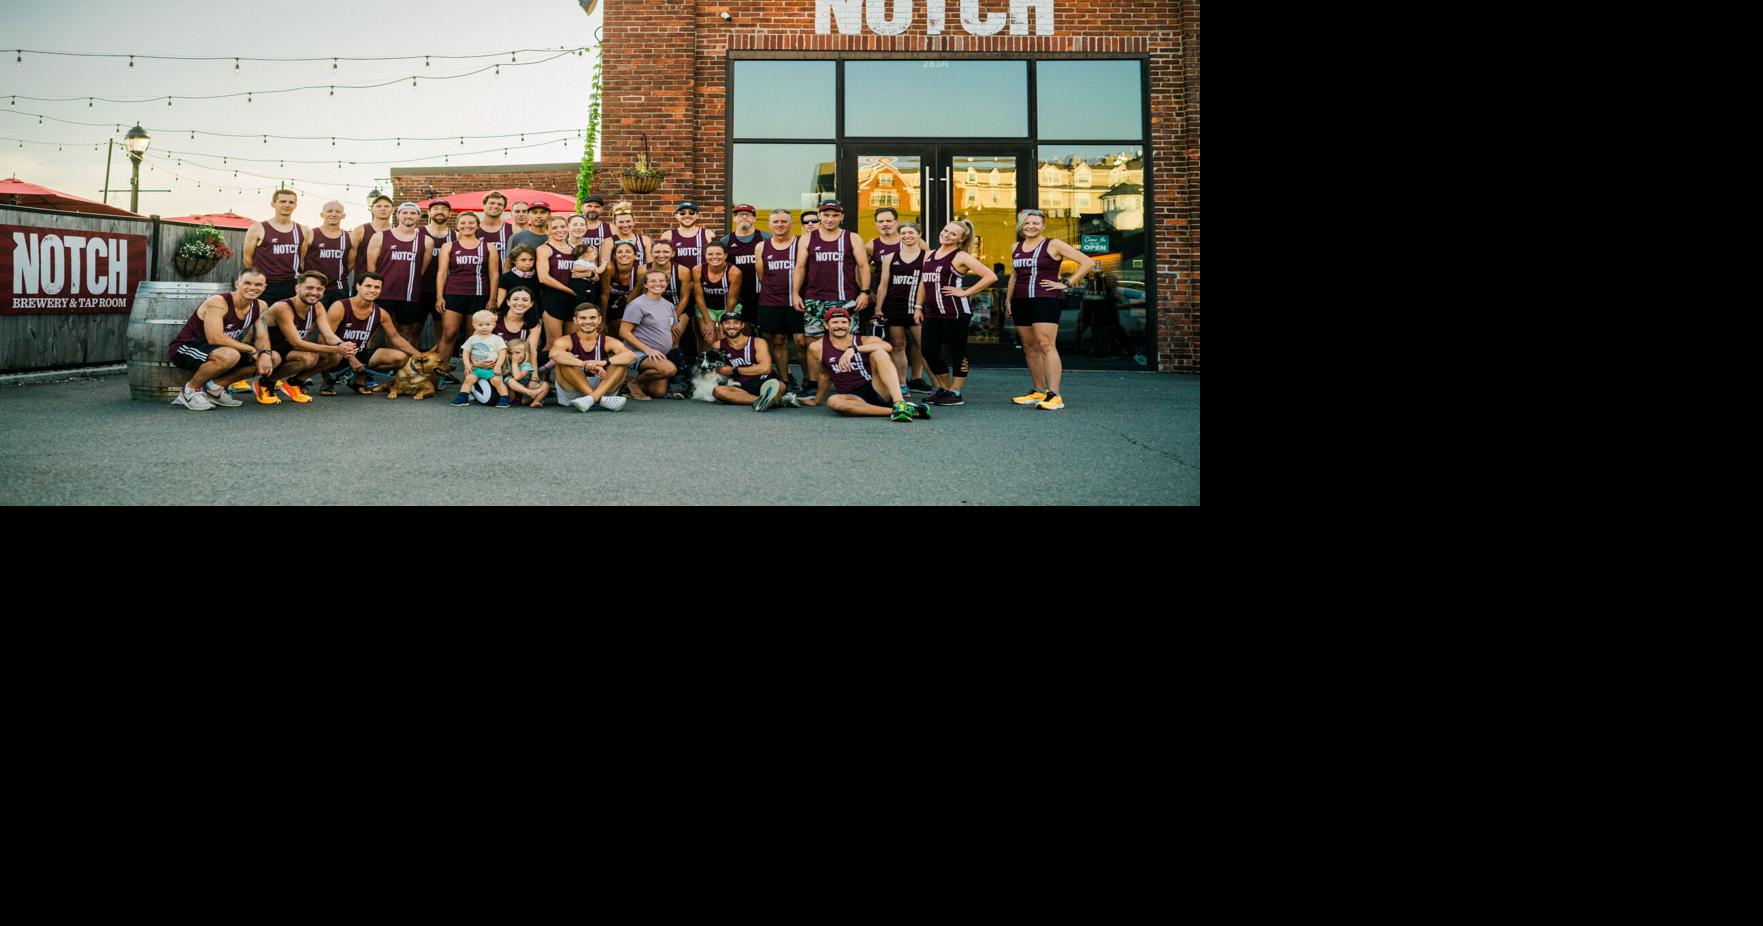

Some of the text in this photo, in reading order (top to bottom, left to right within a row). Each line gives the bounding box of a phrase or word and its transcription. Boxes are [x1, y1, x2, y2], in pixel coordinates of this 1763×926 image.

[273, 244, 299, 255] NOTCH
[319, 249, 345, 259] NOTCH
[677, 247, 702, 257] NOTCH
[391, 250, 416, 261] NOTCH
[455, 255, 484, 265] NOTCH
[735, 255, 756, 265] NOTC
[815, 252, 845, 262] NOTCH
[12, 231, 128, 295] NOTCH
[557, 259, 574, 270] NOT
[768, 260, 796, 271] NOTCH
[1013, 258, 1038, 268] NOTCH
[892, 275, 919, 286] NOTCH
[12, 297, 68, 309] BREWERY
[68, 298, 77, 308] &
[343, 329, 371, 341] NOTCH
[831, 362, 864, 374] NCH
